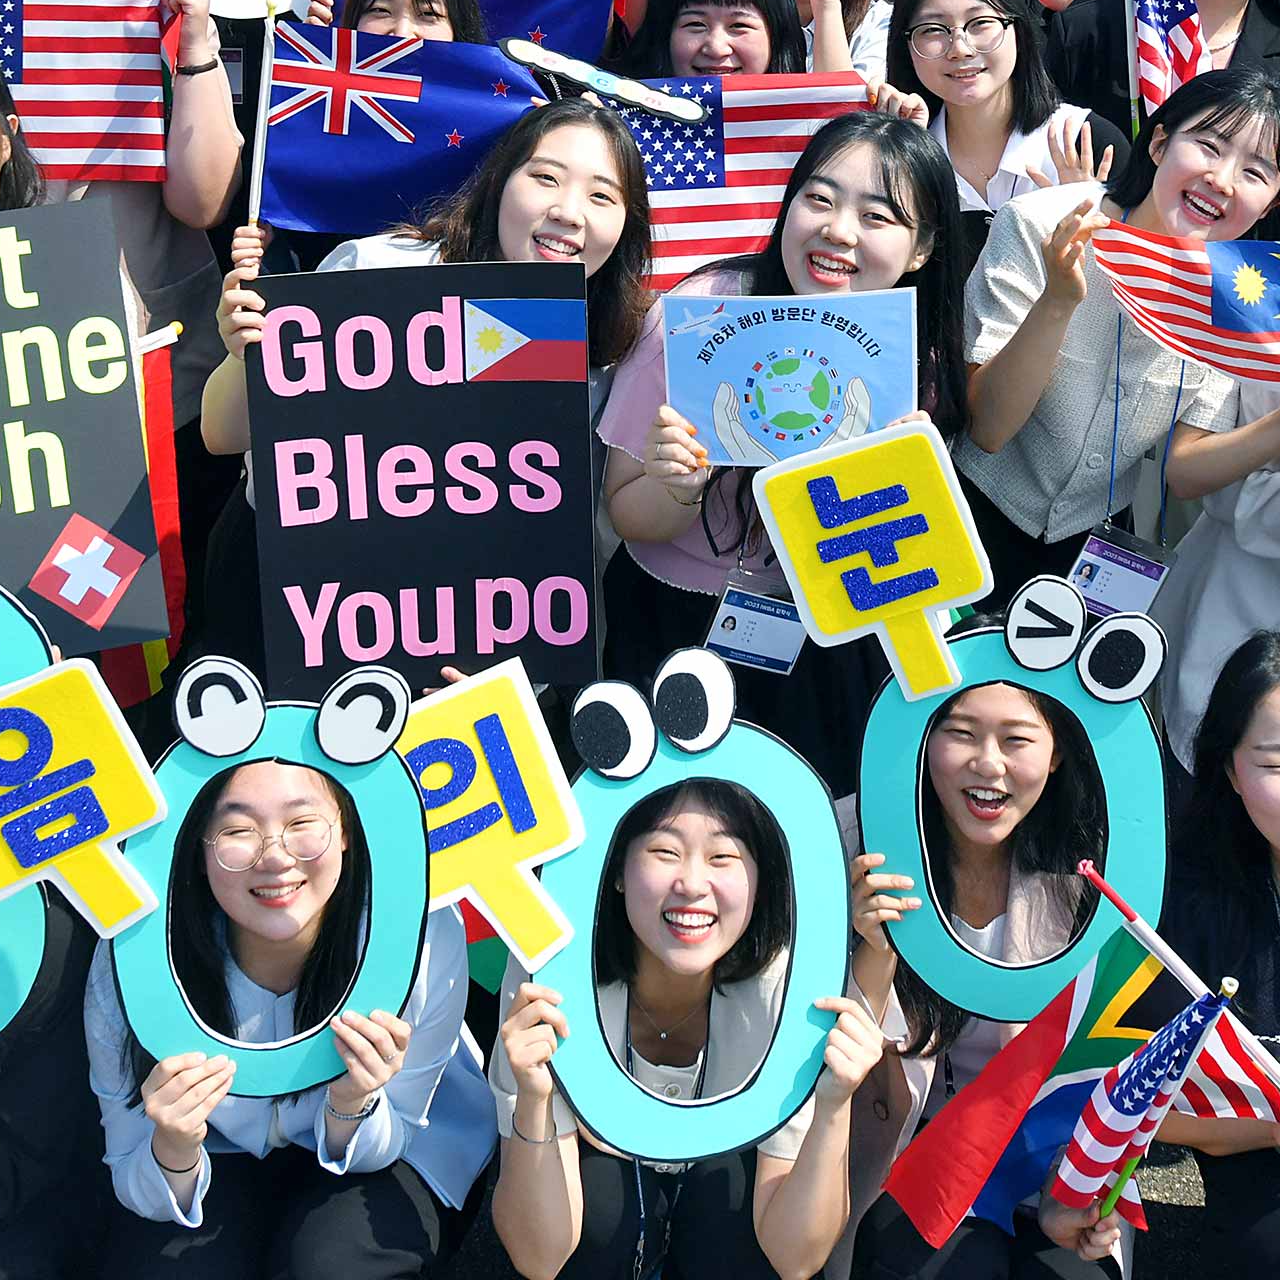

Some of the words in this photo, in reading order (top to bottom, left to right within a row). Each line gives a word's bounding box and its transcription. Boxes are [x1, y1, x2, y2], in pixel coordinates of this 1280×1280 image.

[259, 295, 466, 398] God
[737, 309, 768, 331] 해외
[771, 306, 818, 323] 방문단
[820, 310, 883, 360] 환영합니다
[273, 433, 564, 528] Bless
[805, 474, 940, 613] 눈
[282, 580, 457, 668] You
[475, 574, 590, 656] po
[417, 712, 538, 854] 의
